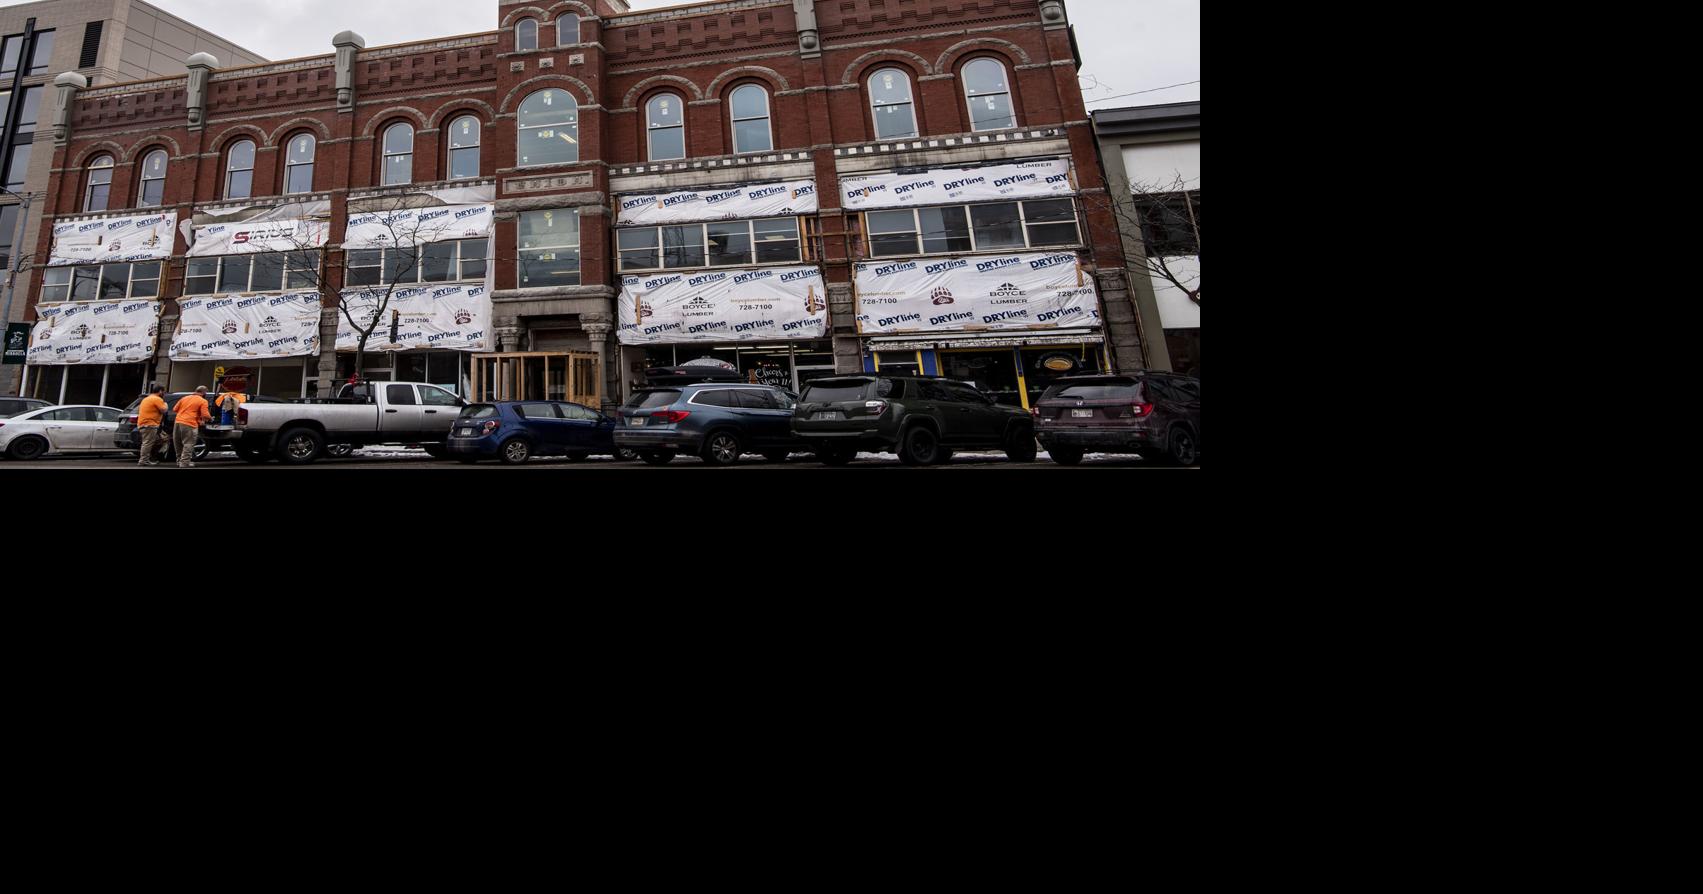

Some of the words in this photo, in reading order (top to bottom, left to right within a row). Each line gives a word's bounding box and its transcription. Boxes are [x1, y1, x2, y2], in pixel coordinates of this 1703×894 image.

[847, 184, 886, 198] DRYline
[894, 180, 935, 194] DRYline
[943, 176, 985, 191] DRYline
[993, 173, 1036, 187] DRYline
[622, 196, 657, 209] DRYline
[663, 193, 698, 206] DRYline
[706, 189, 741, 203] DRYline
[749, 185, 786, 200] DRYline
[417, 209, 449, 221] DRYline
[455, 206, 486, 218] DRYline
[232, 227, 294, 245] SIRIUS
[875, 261, 917, 276] DRYline
[925, 259, 967, 273] DRYline
[976, 256, 1021, 271] DRYline
[1029, 254, 1076, 269] DRYline
[645, 275, 681, 288] DRYline
[688, 272, 726, 286] DRYline
[733, 270, 772, 284] DRYline
[780, 268, 819, 281] DRYline
[395, 287, 427, 299] DRYline
[65, 305, 90, 317] DRYline
[93, 303, 119, 315] DRYline
[123, 302, 149, 314] DRYline
[207, 299, 233, 310] DRYline
[237, 296, 266, 308] DRYline
[270, 294, 299, 306] DRYline
[878, 312, 920, 327] DRYline
[929, 310, 973, 325] DRYline
[982, 309, 1027, 324] DRYline
[1036, 305, 1081, 322] DRYline
[644, 322, 680, 335] DRYline
[688, 320, 726, 334] DRYline
[734, 319, 774, 333] DRYline
[782, 318, 822, 332] DRYline
[201, 340, 230, 351] DRYline
[235, 338, 263, 349] DRYline
[268, 335, 298, 348] DRYline
[428, 330, 460, 342] DRYline
[466, 331, 483, 341] DRY
[56, 344, 82, 354] DRYline
[86, 343, 112, 353] DRYline
[116, 343, 141, 353] DRYline
